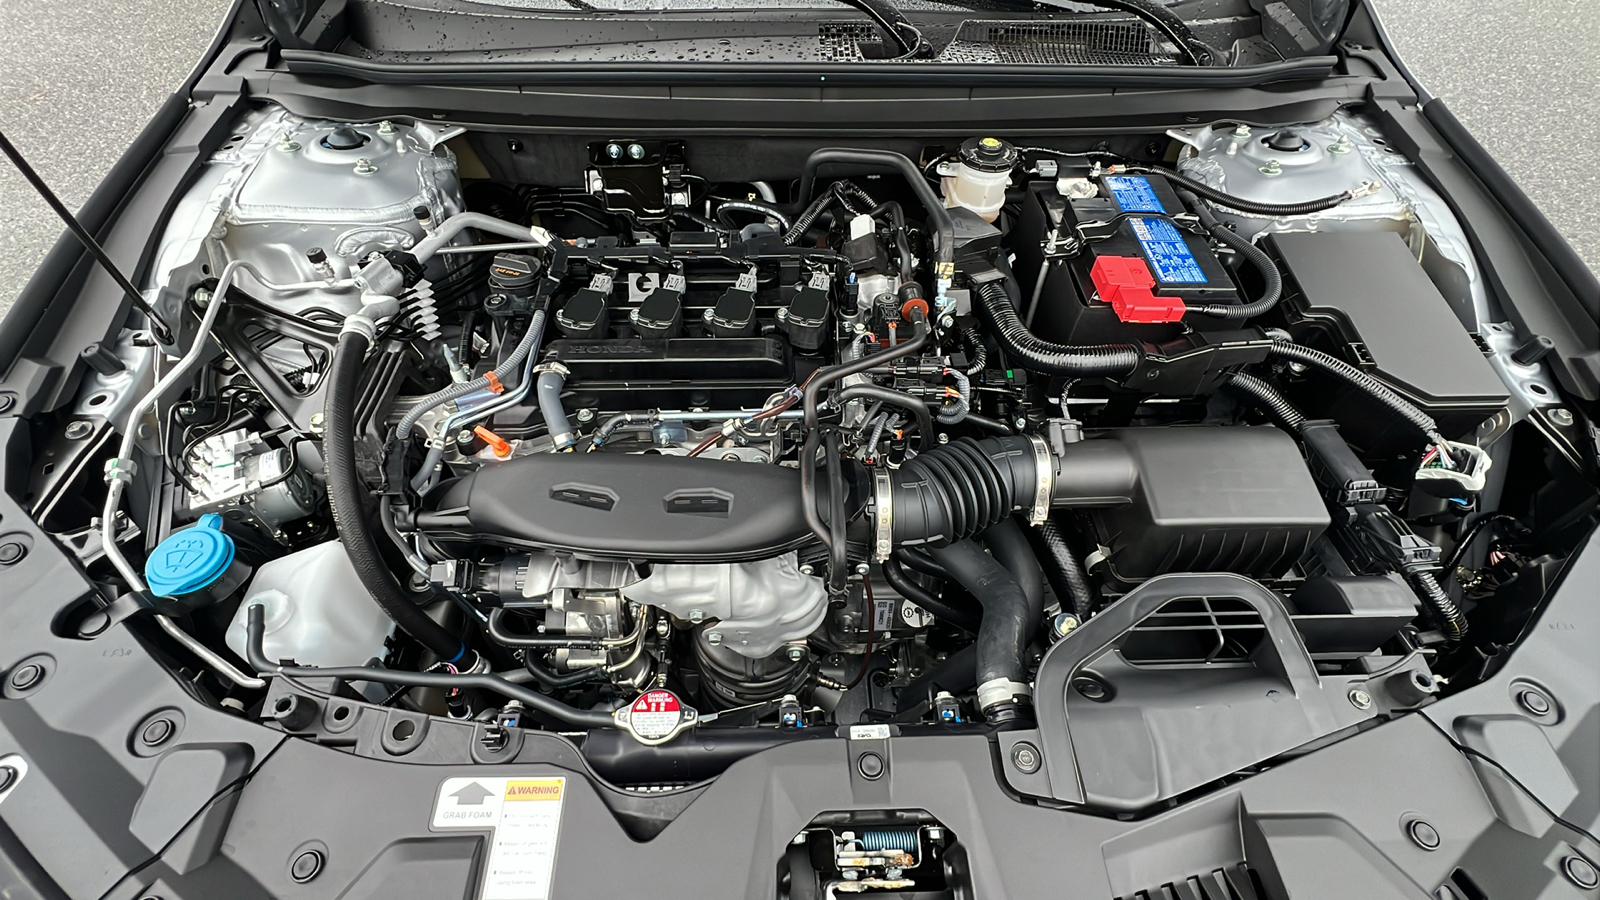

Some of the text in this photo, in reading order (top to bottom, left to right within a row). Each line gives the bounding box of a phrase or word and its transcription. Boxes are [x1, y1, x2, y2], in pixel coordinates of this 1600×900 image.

[567, 345, 653, 354] HONDA
[326, 485, 340, 522] NICHIRIN
[517, 786, 560, 795] WARNING
[442, 811, 493, 819] GRAB FOAM
